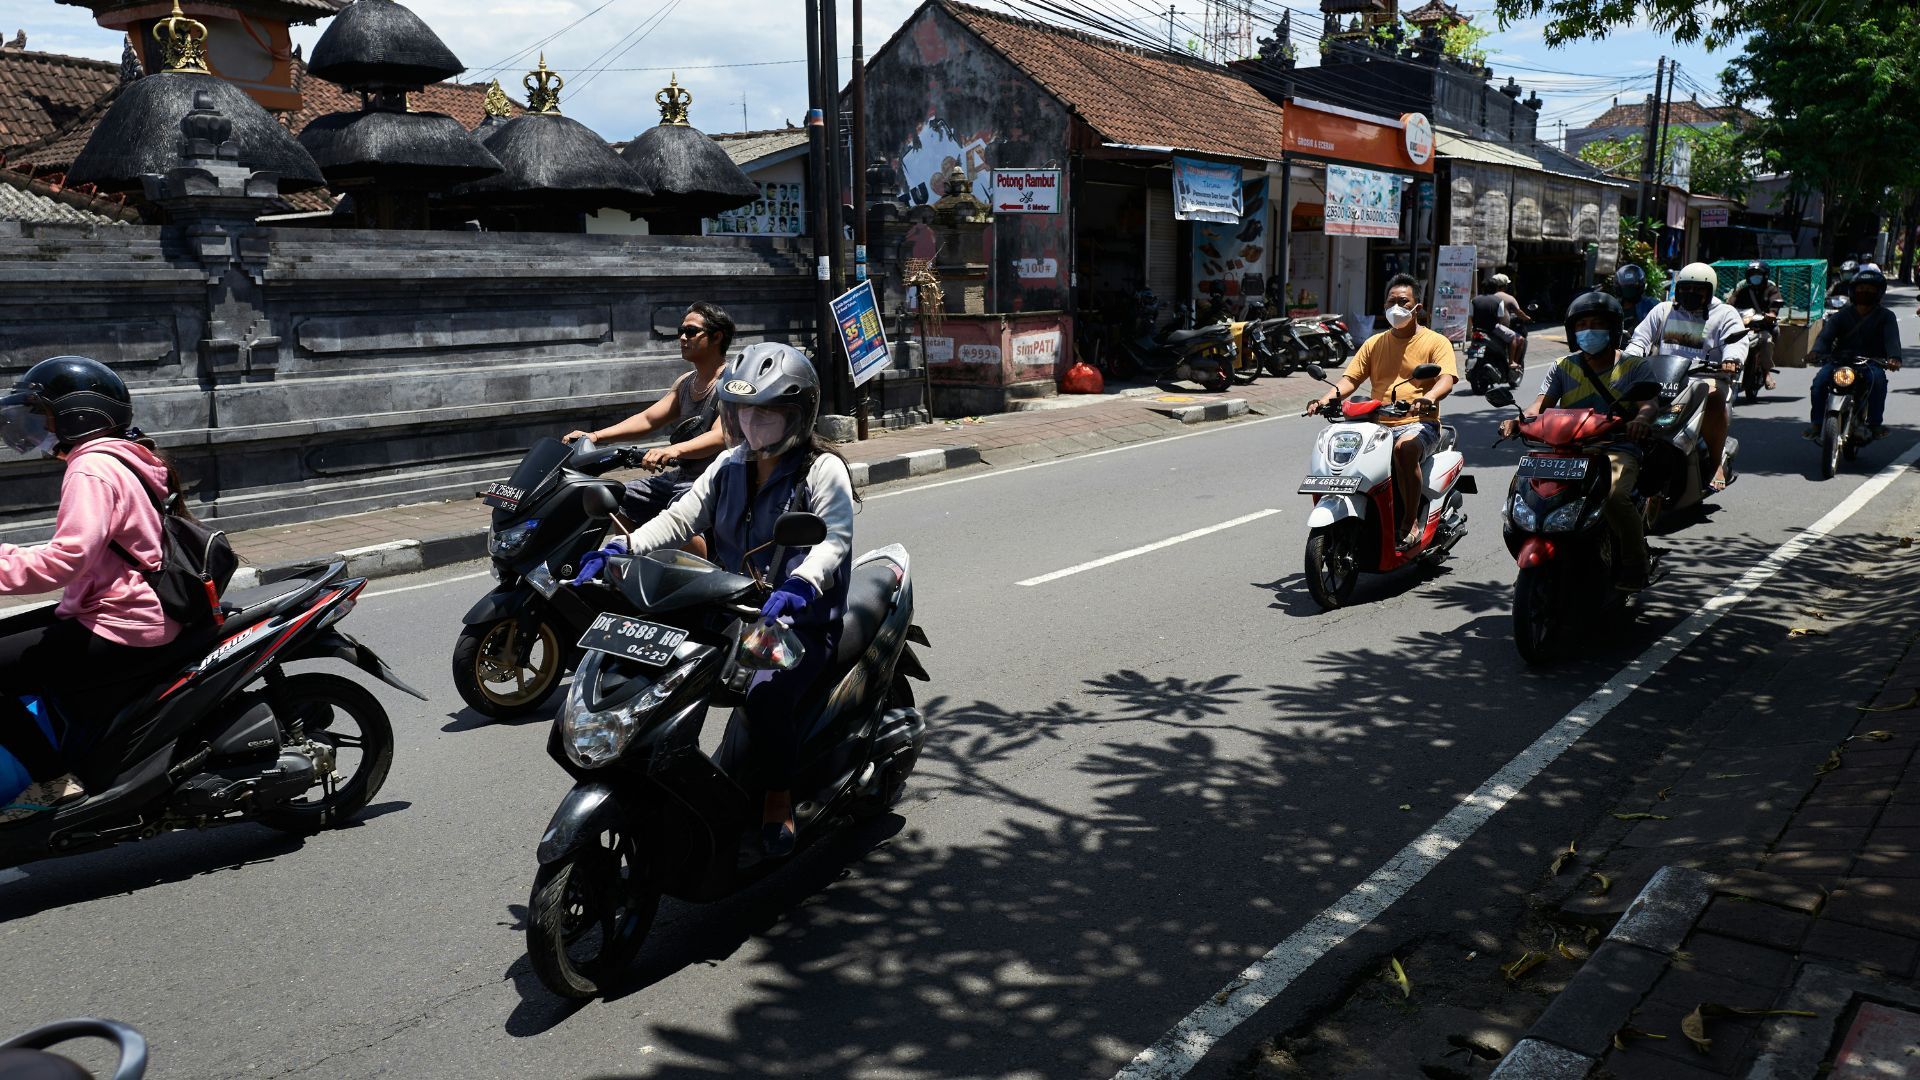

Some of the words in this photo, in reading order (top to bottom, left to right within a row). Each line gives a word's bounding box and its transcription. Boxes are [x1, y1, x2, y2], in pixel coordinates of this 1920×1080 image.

[997, 173, 1024, 191] Potong
[1025, 173, 1056, 188] Rambut
[1016, 339, 1055, 356] simPATI
[1521, 458, 1535, 467] DK
[1540, 459, 1567, 469] 5372
[488, 482, 499, 493] DK
[592, 616, 617, 631] DK
[616, 621, 658, 640] 3688
